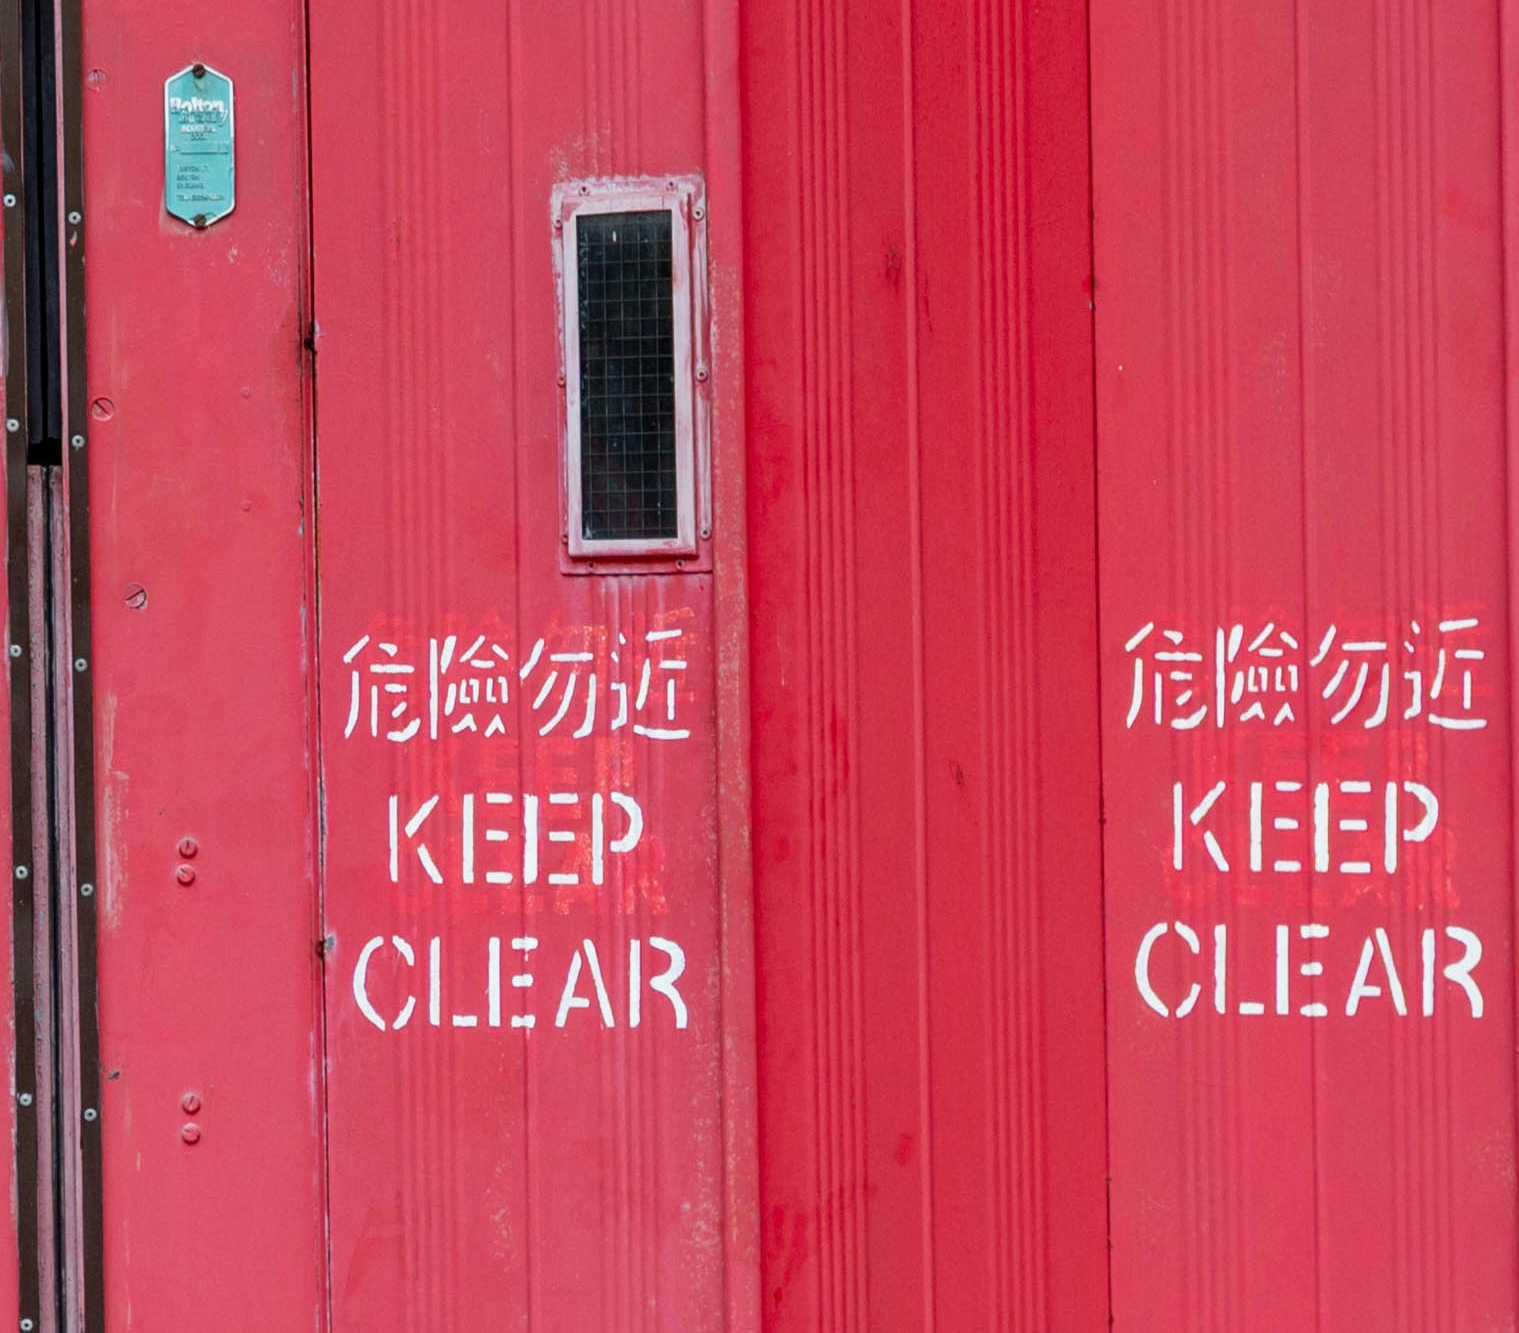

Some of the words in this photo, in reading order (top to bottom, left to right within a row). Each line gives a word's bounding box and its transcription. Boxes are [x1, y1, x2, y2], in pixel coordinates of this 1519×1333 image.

[343, 629, 690, 742] 危險勿近
[1125, 618, 1487, 730] 危險勿近
[389, 791, 643, 887] KEEP
[1173, 781, 1439, 874] KEEP
[351, 933, 688, 1033] CLEAR
[1135, 921, 1483, 1018] CLEAR
